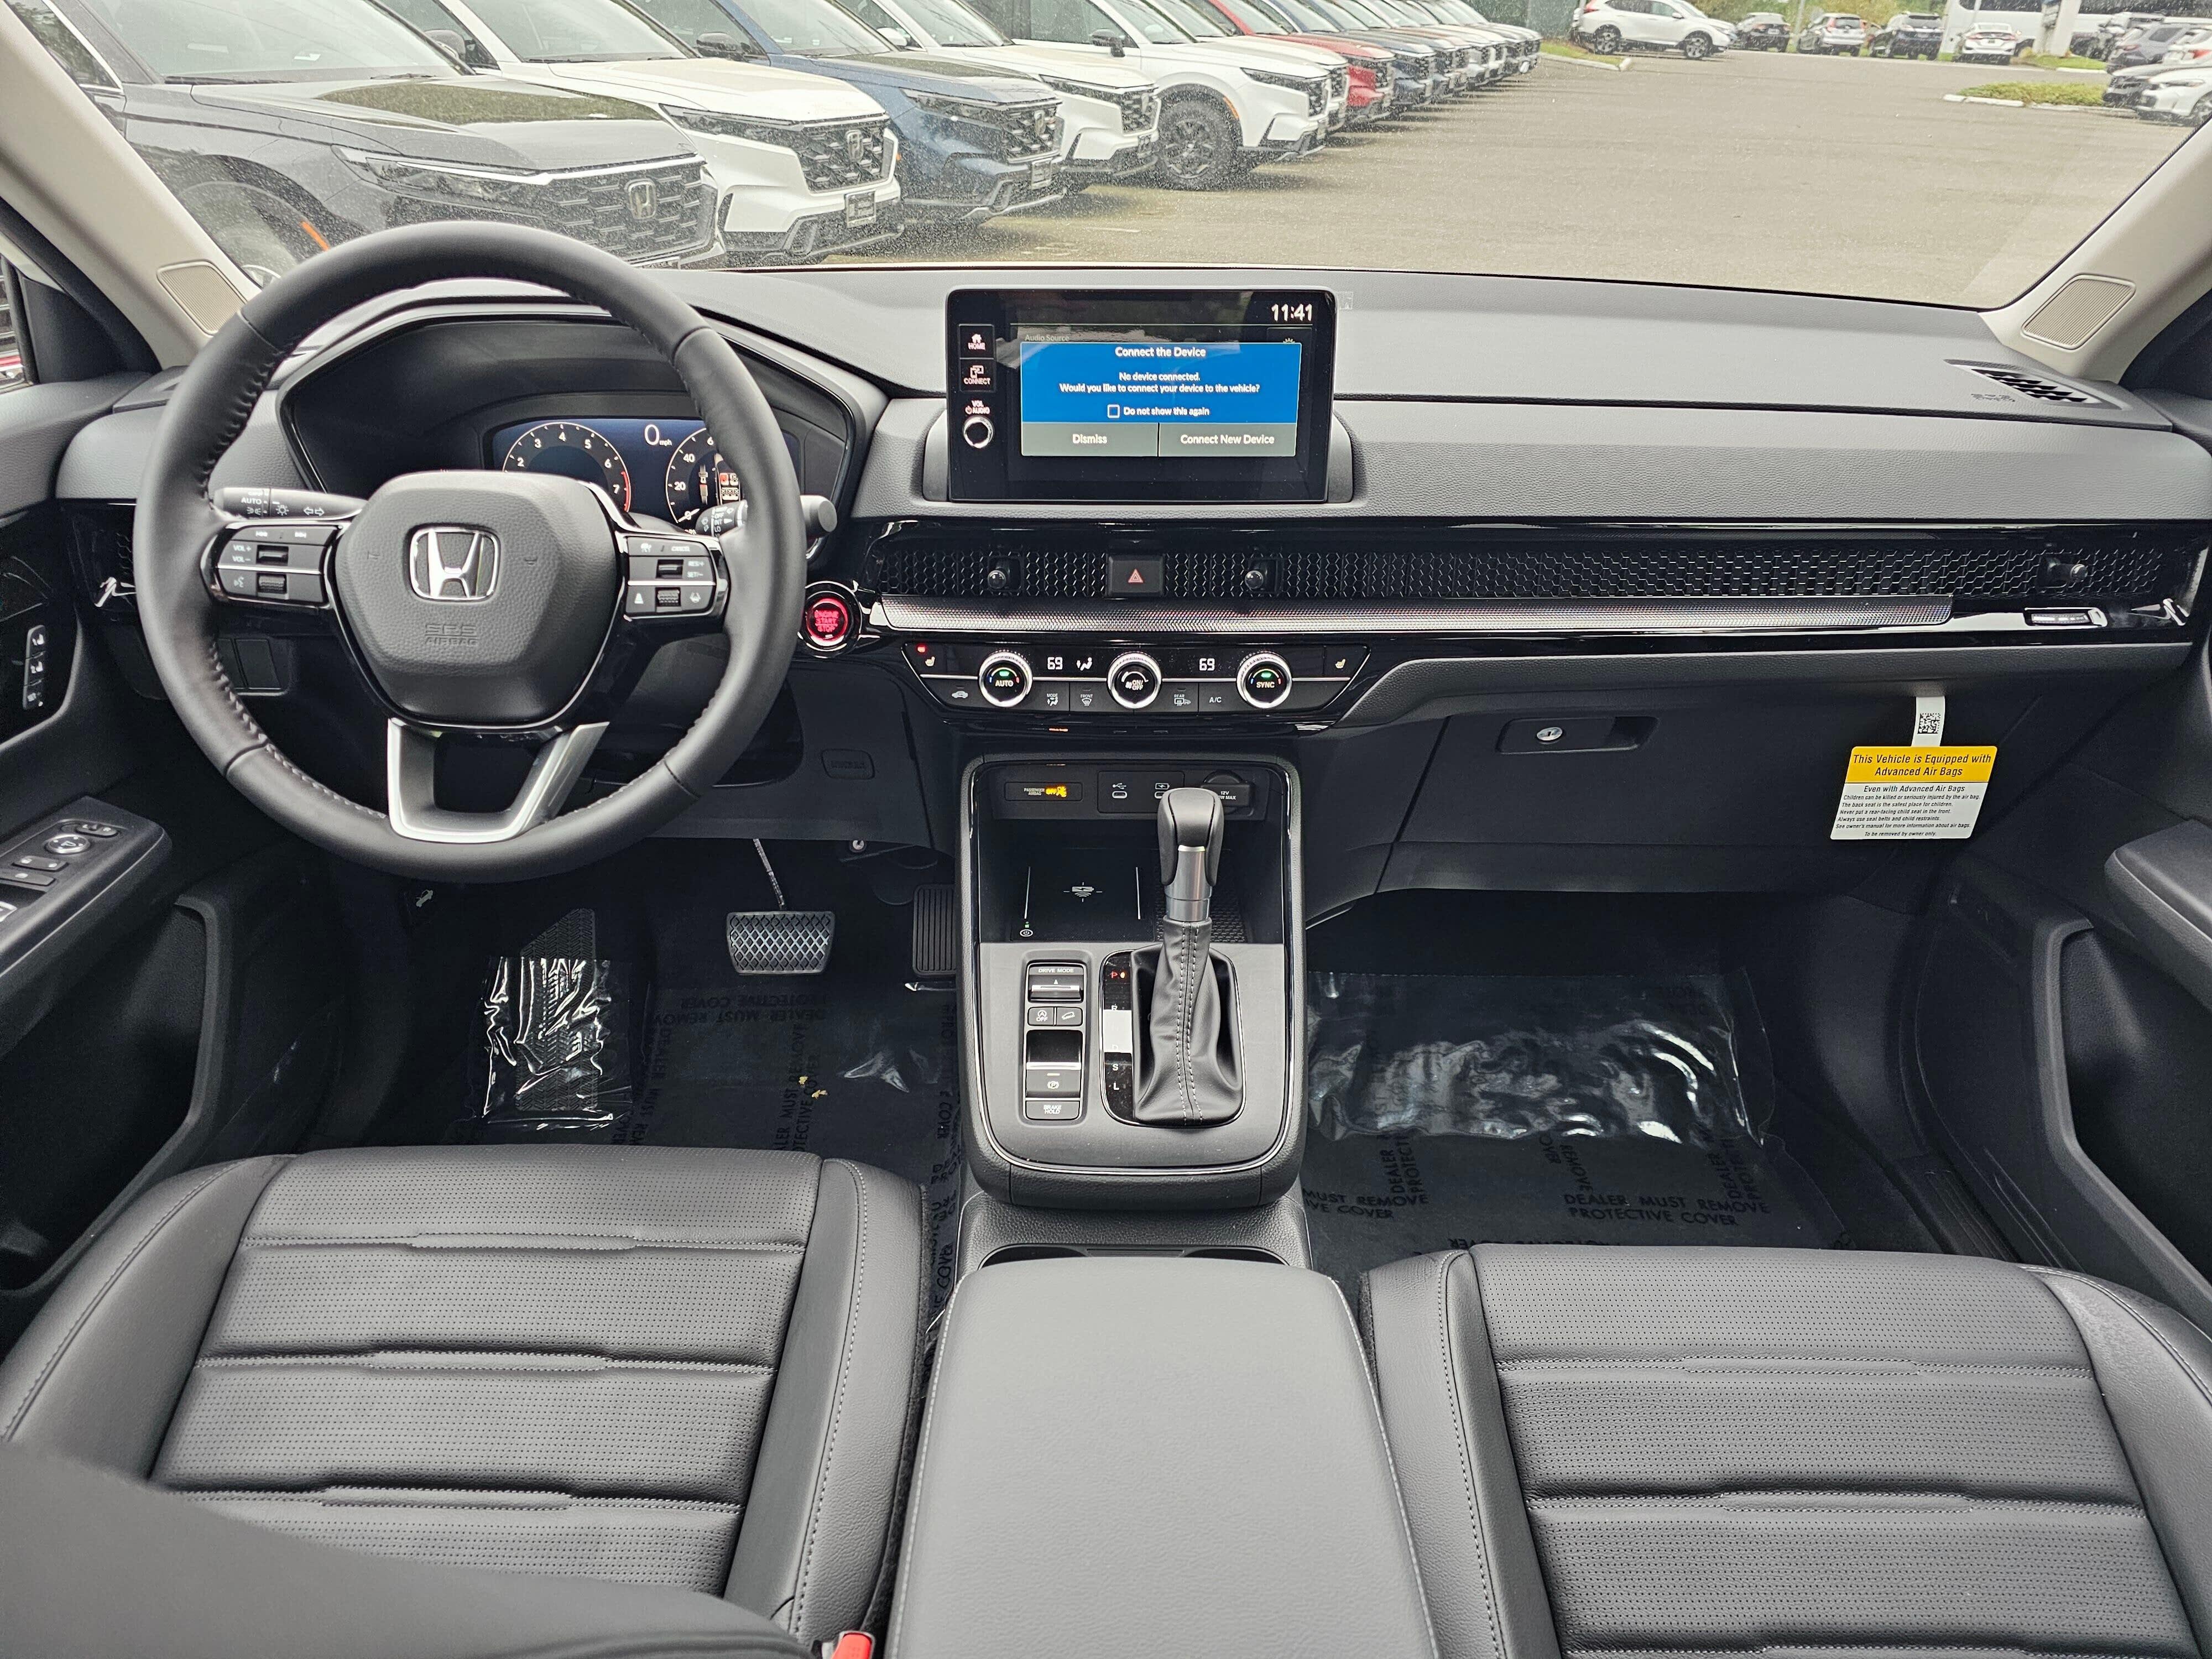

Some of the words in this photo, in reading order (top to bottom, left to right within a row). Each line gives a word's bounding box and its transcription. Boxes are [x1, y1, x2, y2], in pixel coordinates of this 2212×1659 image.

[1271, 304, 1312, 321] 11:41
[1115, 347, 1155, 357] Connect
[1156, 347, 1171, 357] the
[1173, 347, 1206, 357] Device
[1119, 372, 1131, 381] No
[1133, 372, 1157, 381] device
[1159, 372, 1200, 381] connected.
[1059, 383, 1086, 393] Would
[1087, 385, 1101, 393] you
[1103, 383, 1117, 393] like
[1118, 383, 1126, 393] to
[1127, 384, 1158, 393] connect
[1160, 385, 1177, 394] your
[1178, 383, 1203, 393] device
[1205, 383, 1213, 393] to
[1215, 383, 1228, 393] the
[1229, 383, 1260, 393] vehicle?
[1123, 407, 1135, 415] Do
[1137, 407, 1150, 415] not
[1151, 407, 1172, 415] show
[1173, 407, 1187, 415] this
[1188, 407, 1209, 416] again
[559, 432, 566, 441] 4
[645, 424, 659, 445] 0
[1072, 434, 1107, 444] Dismiss
[534, 439, 541, 448] 3
[585, 439, 592, 449] 5
[1181, 435, 1218, 445] Connect
[1220, 435, 1241, 445] New
[1243, 435, 1275, 445] Device
[517, 457, 524, 467] 2
[604, 458, 612, 468] 6
[683, 453, 695, 463] 40
[613, 484, 620, 494] 7
[674, 482, 686, 491] 20
[1047, 657, 1063, 670] 69
[1199, 658, 1215, 671] 69
[1854, 755, 1872, 763] This
[1876, 755, 1910, 763] Vehicle
[1913, 755, 1922, 763] is
[1925, 755, 1969, 765] Equipped
[1971, 754, 1991, 763] with
[1939, 768, 1963, 777] Bags
[1380, 1150, 1405, 1193] DEALER
[1302, 1188, 1346, 1203] MUST
[1357, 1194, 1430, 1207] REMOVE
[1564, 1193, 1627, 1206] DEALER
[1639, 1196, 1686, 1208] MUST
[1697, 1198, 1771, 1214] REMOVE
[1338, 1206, 1394, 1219] COVER
[1568, 1207, 1674, 1223] PROTECTIVE
[1682, 1212, 1739, 1227] COVER
